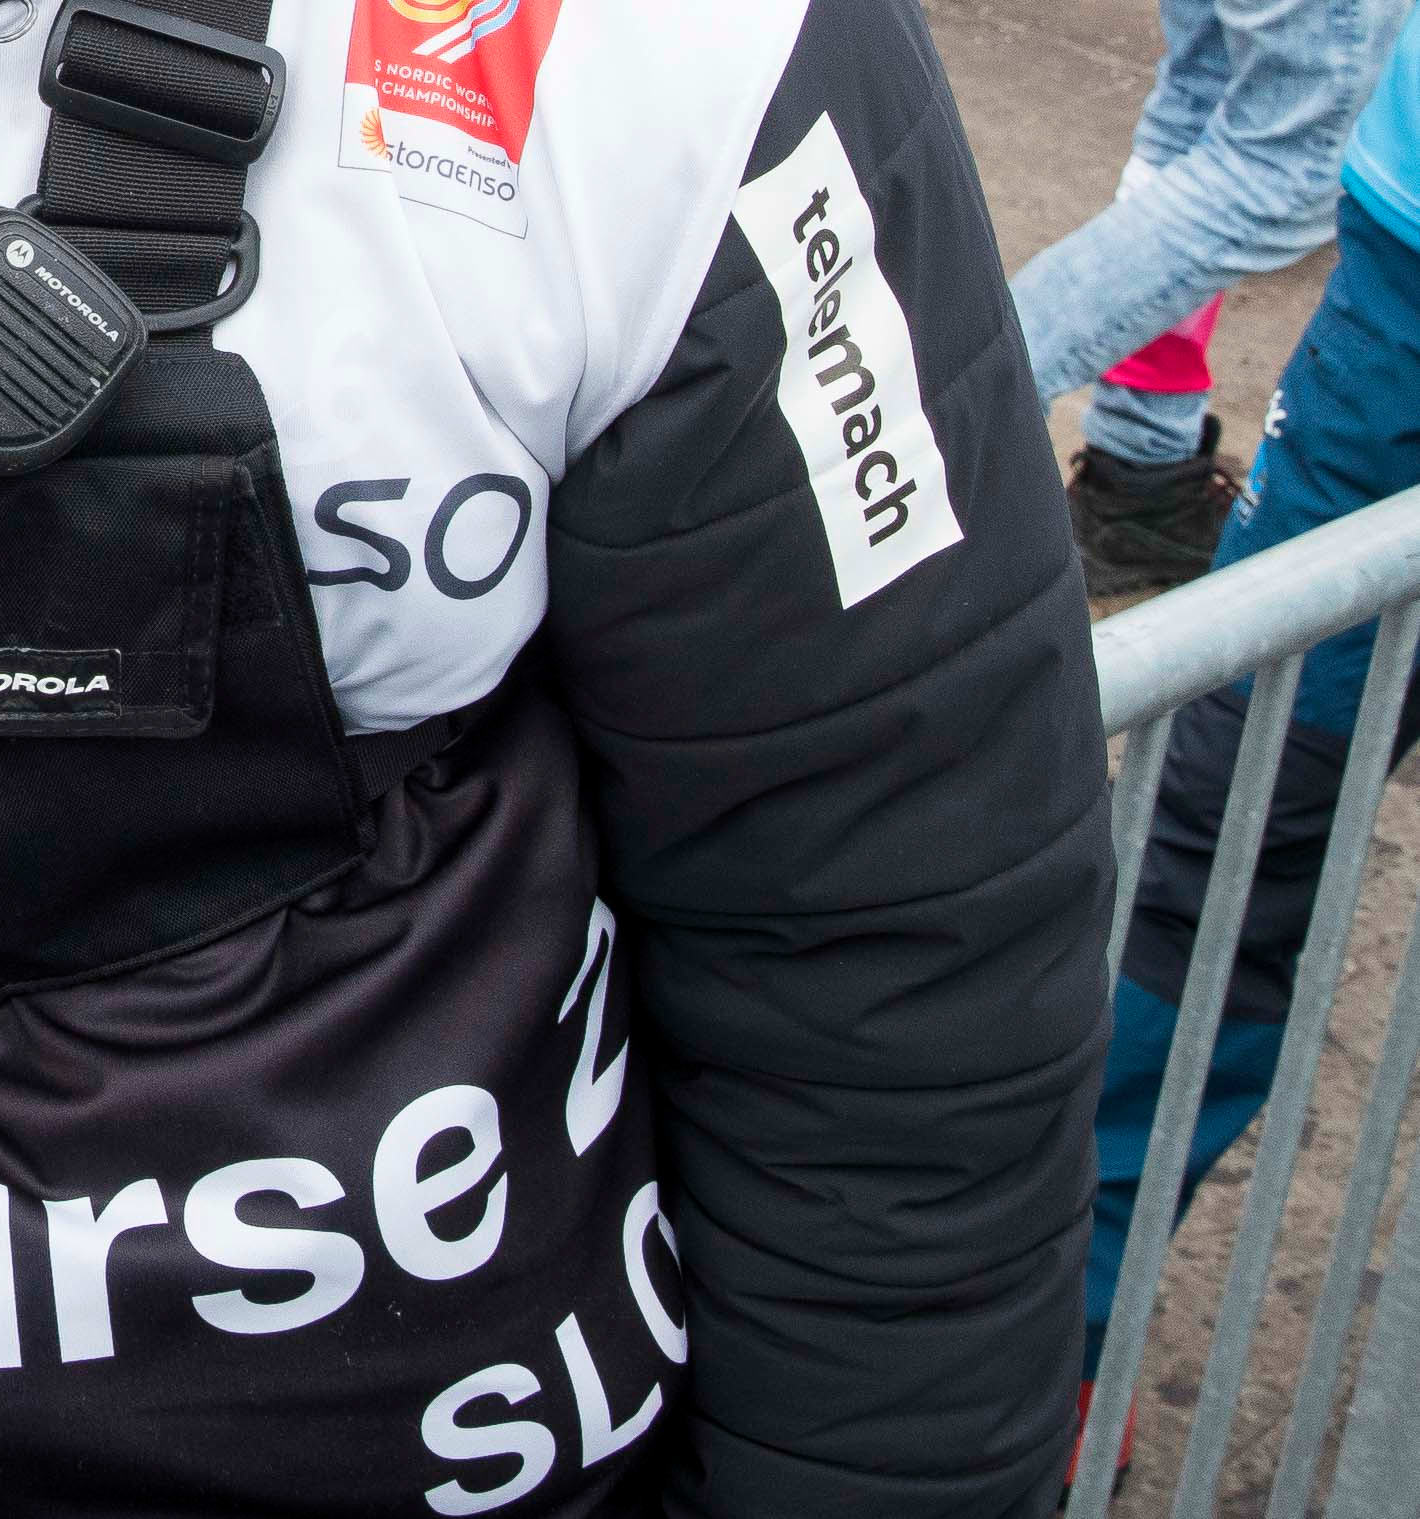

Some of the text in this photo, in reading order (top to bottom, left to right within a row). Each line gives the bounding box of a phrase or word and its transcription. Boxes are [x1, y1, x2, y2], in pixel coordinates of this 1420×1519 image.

[386, 63, 453, 91] NORDIC
[381, 81, 500, 131] CHAMPIONSHIP
[467, 145, 507, 168] Presented
[34, 265, 120, 343] MOTOROLA
[792, 186, 918, 548] telemach
